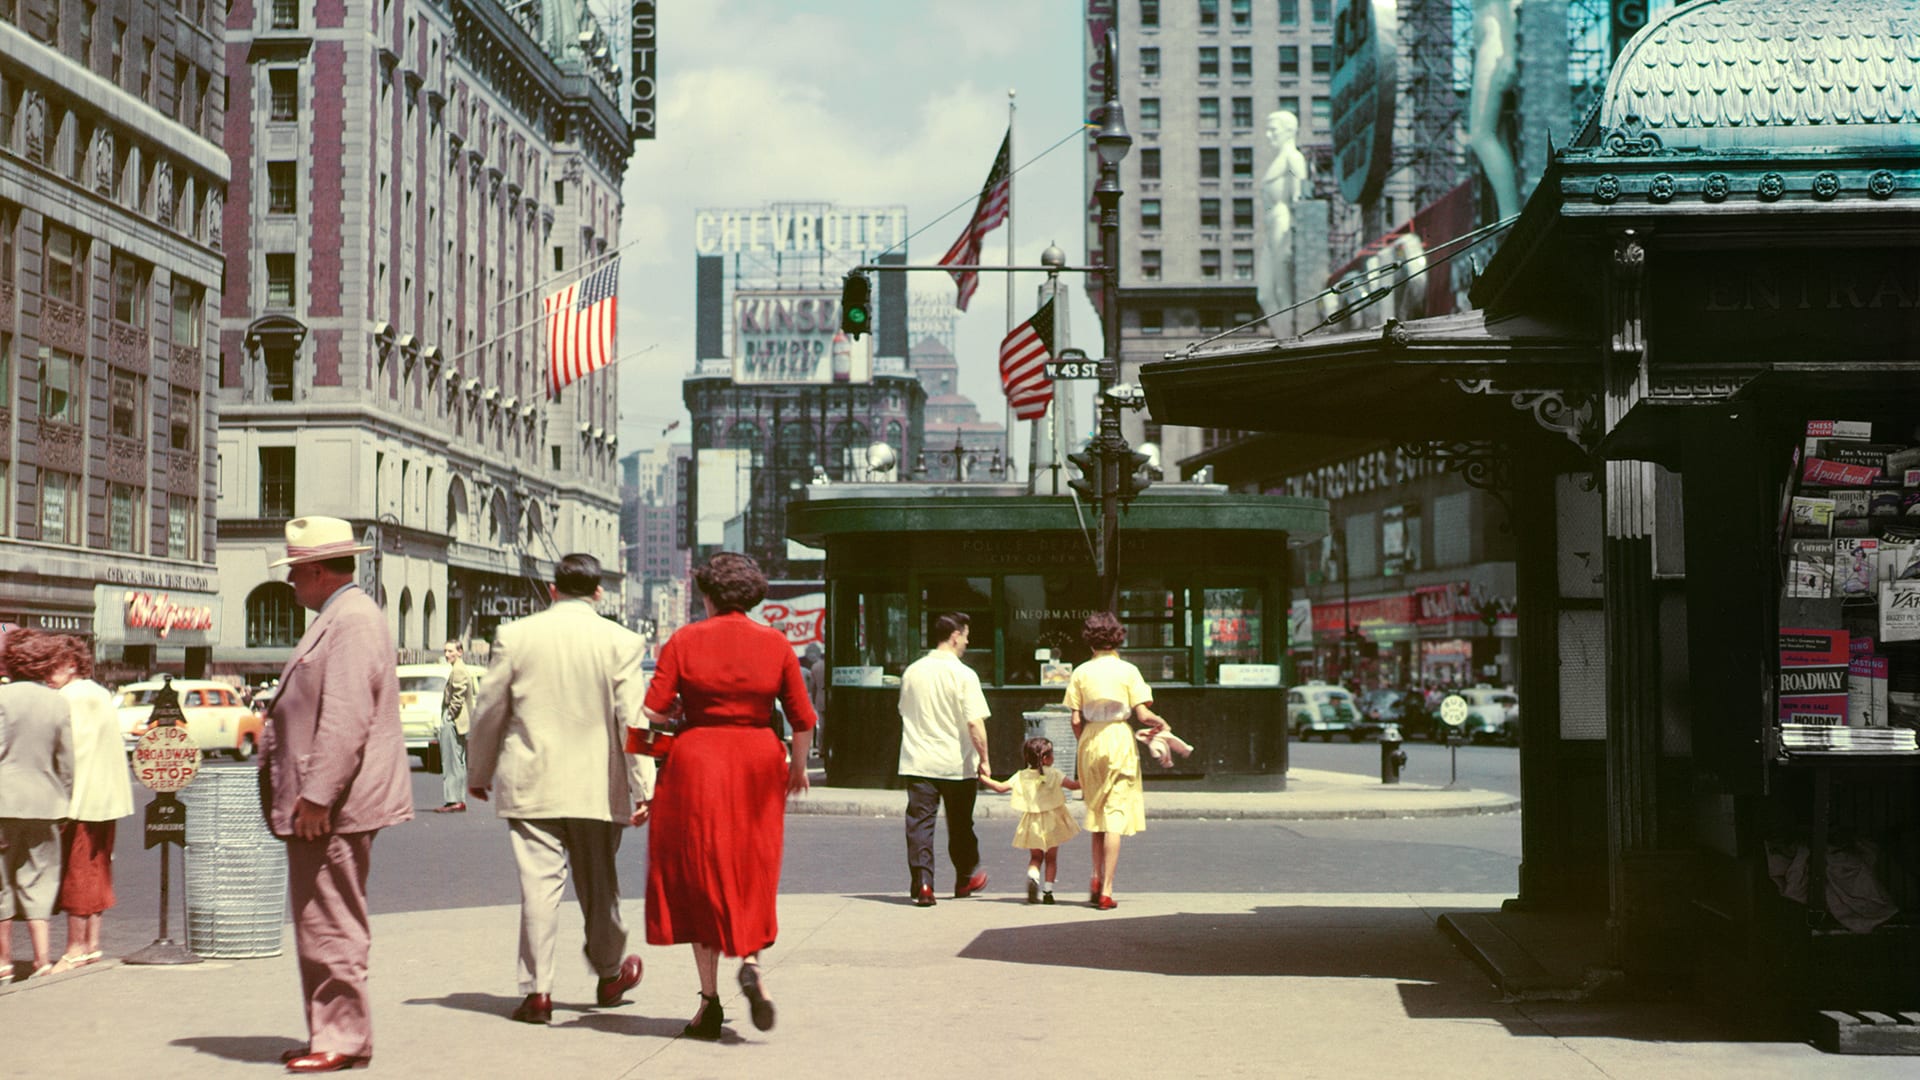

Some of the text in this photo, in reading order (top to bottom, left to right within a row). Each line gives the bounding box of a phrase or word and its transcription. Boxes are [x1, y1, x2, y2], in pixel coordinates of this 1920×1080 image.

[696, 209, 904, 252] CHEVROLET
[1705, 268, 1920, 310] ENTRA
[740, 299, 840, 333] KINSE
[1046, 363, 1099, 377] W. 43 ST.
[1317, 449, 1391, 499] TROUSER
[1836, 538, 1857, 550] EYE
[106, 566, 139, 585] CHEMICAL
[141, 570, 157, 586] BANK
[165, 573, 182, 589] TRUST
[185, 574, 209, 592] COMPANY
[481, 596, 538, 617] HOTEL
[1015, 607, 1098, 620] INFORMATION
[40, 616, 80, 630] CHILDS
[1780, 671, 1844, 691] ROADWAY
[1794, 715, 1838, 725] HOLIDAY
[136, 748, 198, 762] BROADWAY
[142, 767, 193, 781] STOP
[150, 779, 185, 790] HERE
[158, 806, 176, 814] NO
[146, 823, 185, 832] PARKING
